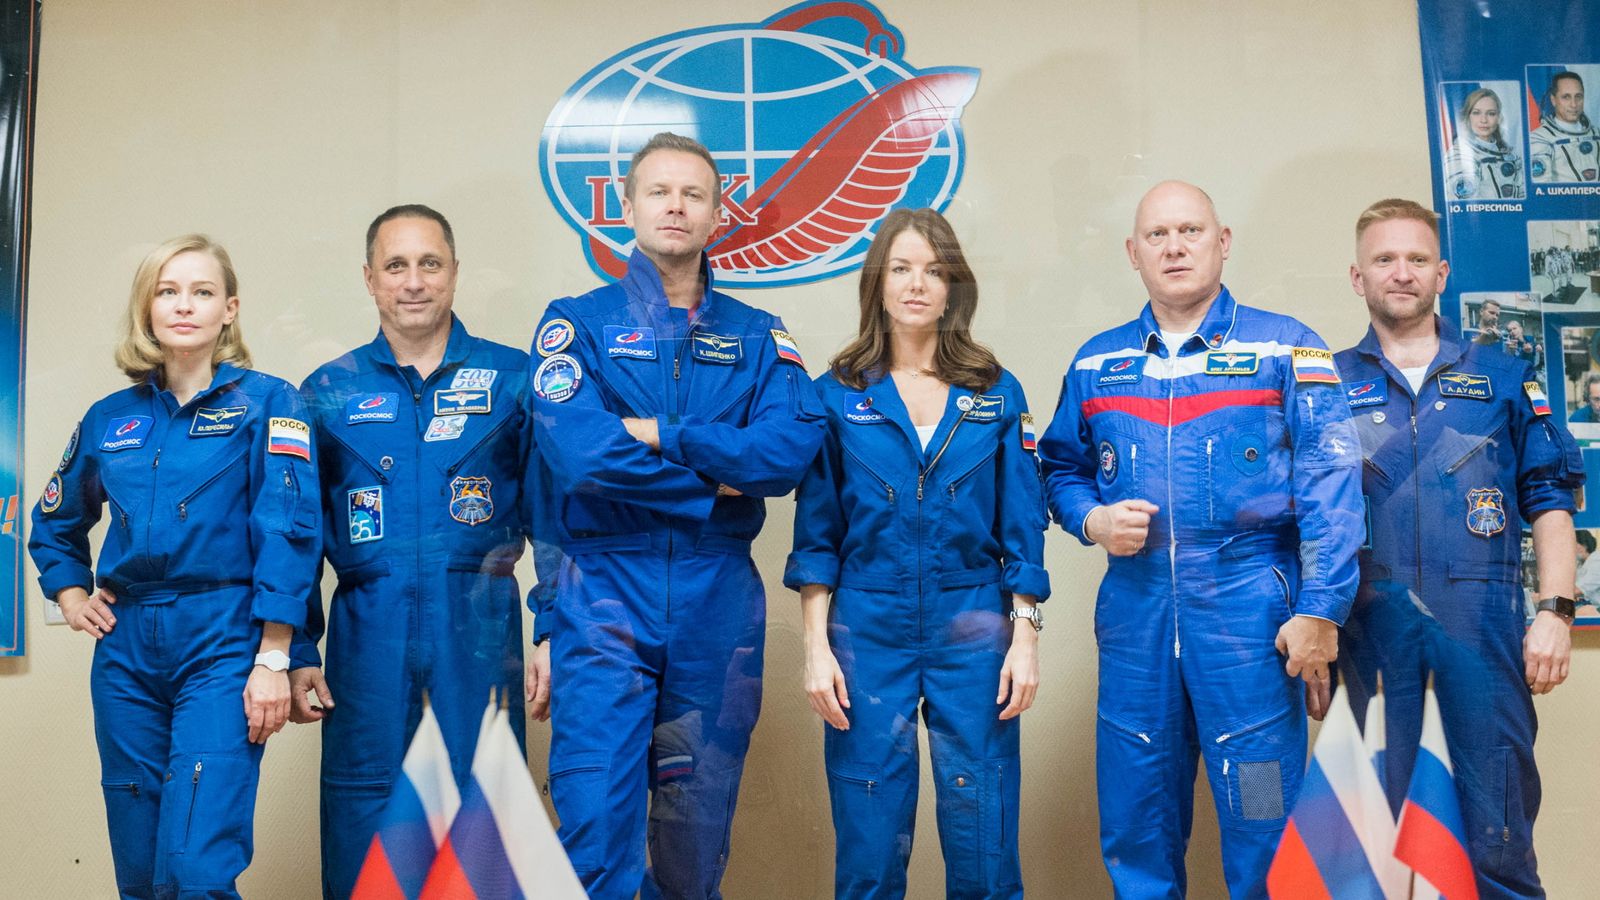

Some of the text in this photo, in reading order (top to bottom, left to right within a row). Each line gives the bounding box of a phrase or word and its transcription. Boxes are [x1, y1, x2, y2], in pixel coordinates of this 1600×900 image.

[1535, 187, 1545, 195] А.
[1449, 204, 1523, 213] Ю. ПЕРЕСИЛЬД
[608, 347, 654, 357] РОСКОСМОС
[1294, 350, 1331, 360] РОССИЯ
[1100, 374, 1138, 383] РОСКОСМОС
[1348, 395, 1384, 406] СКОСМОС
[349, 412, 394, 421] РОСКОСМОС
[104, 438, 142, 448] РОСКОСМОС
[351, 514, 372, 539] 65
